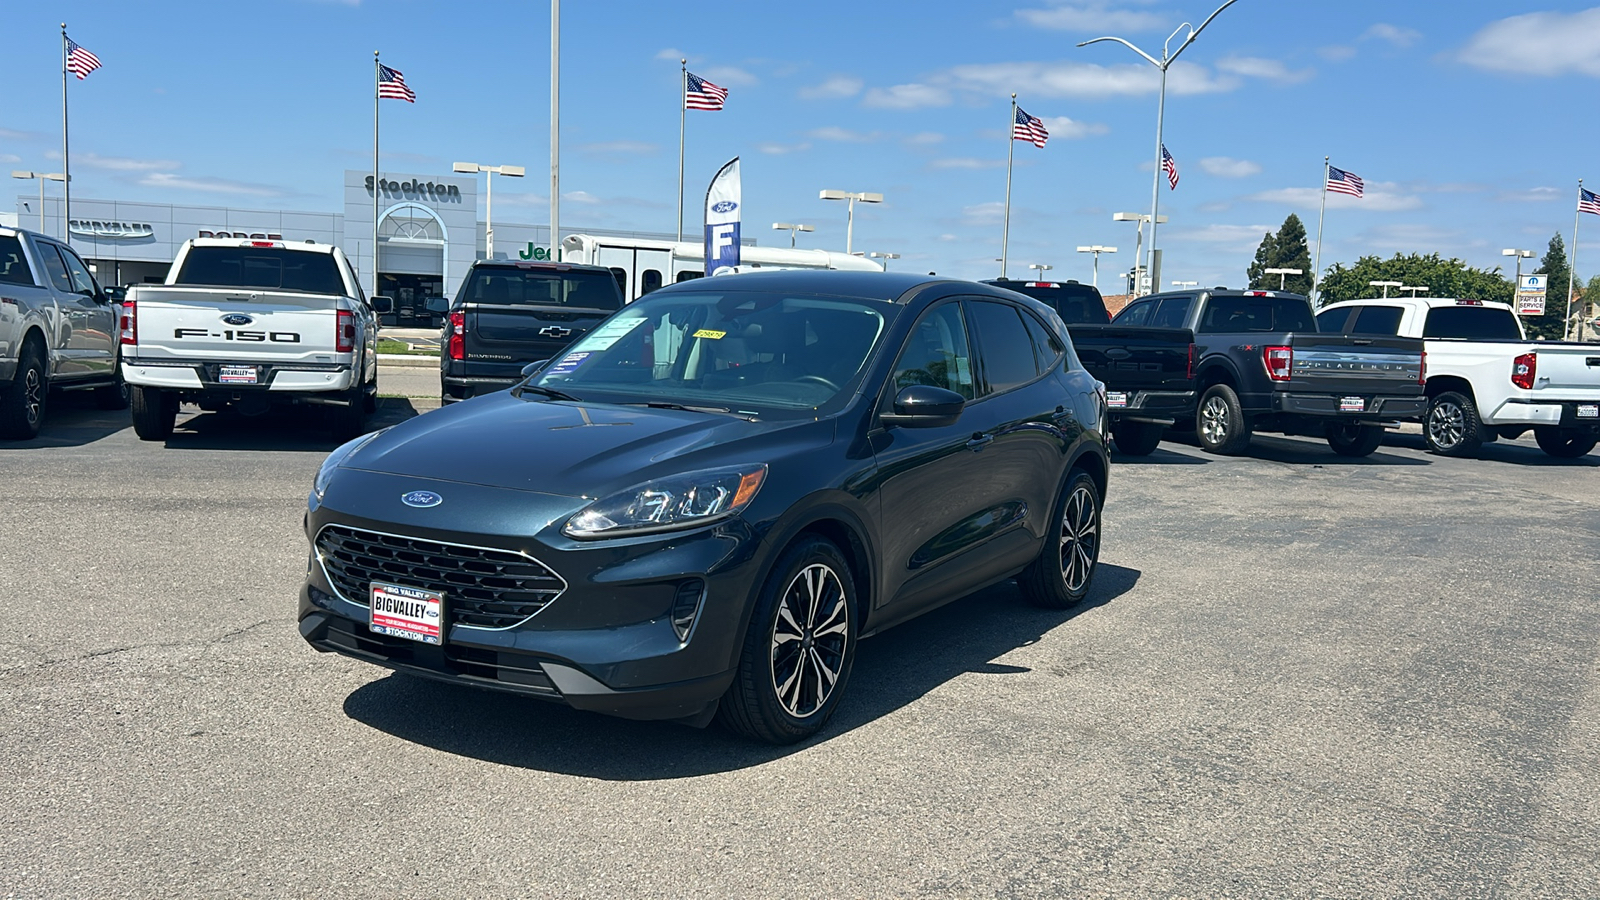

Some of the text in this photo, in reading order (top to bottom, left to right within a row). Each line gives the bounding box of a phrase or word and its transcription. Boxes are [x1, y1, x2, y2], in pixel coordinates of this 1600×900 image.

[364, 175, 460, 196] Stockton
[716, 202, 734, 213] Ford
[69, 220, 153, 231] CHRYSLER
[712, 224, 734, 260] F
[518, 241, 562, 262] Je
[1519, 295, 1538, 303] PARTS
[174, 328, 301, 343] F-150
[1314, 362, 1403, 371] PLATINUM
[408, 493, 433, 503] Ford
[400, 589, 425, 599] VALLEY
[375, 596, 426, 619] BIGVALLEY
[385, 626, 424, 641] STOCKTON
